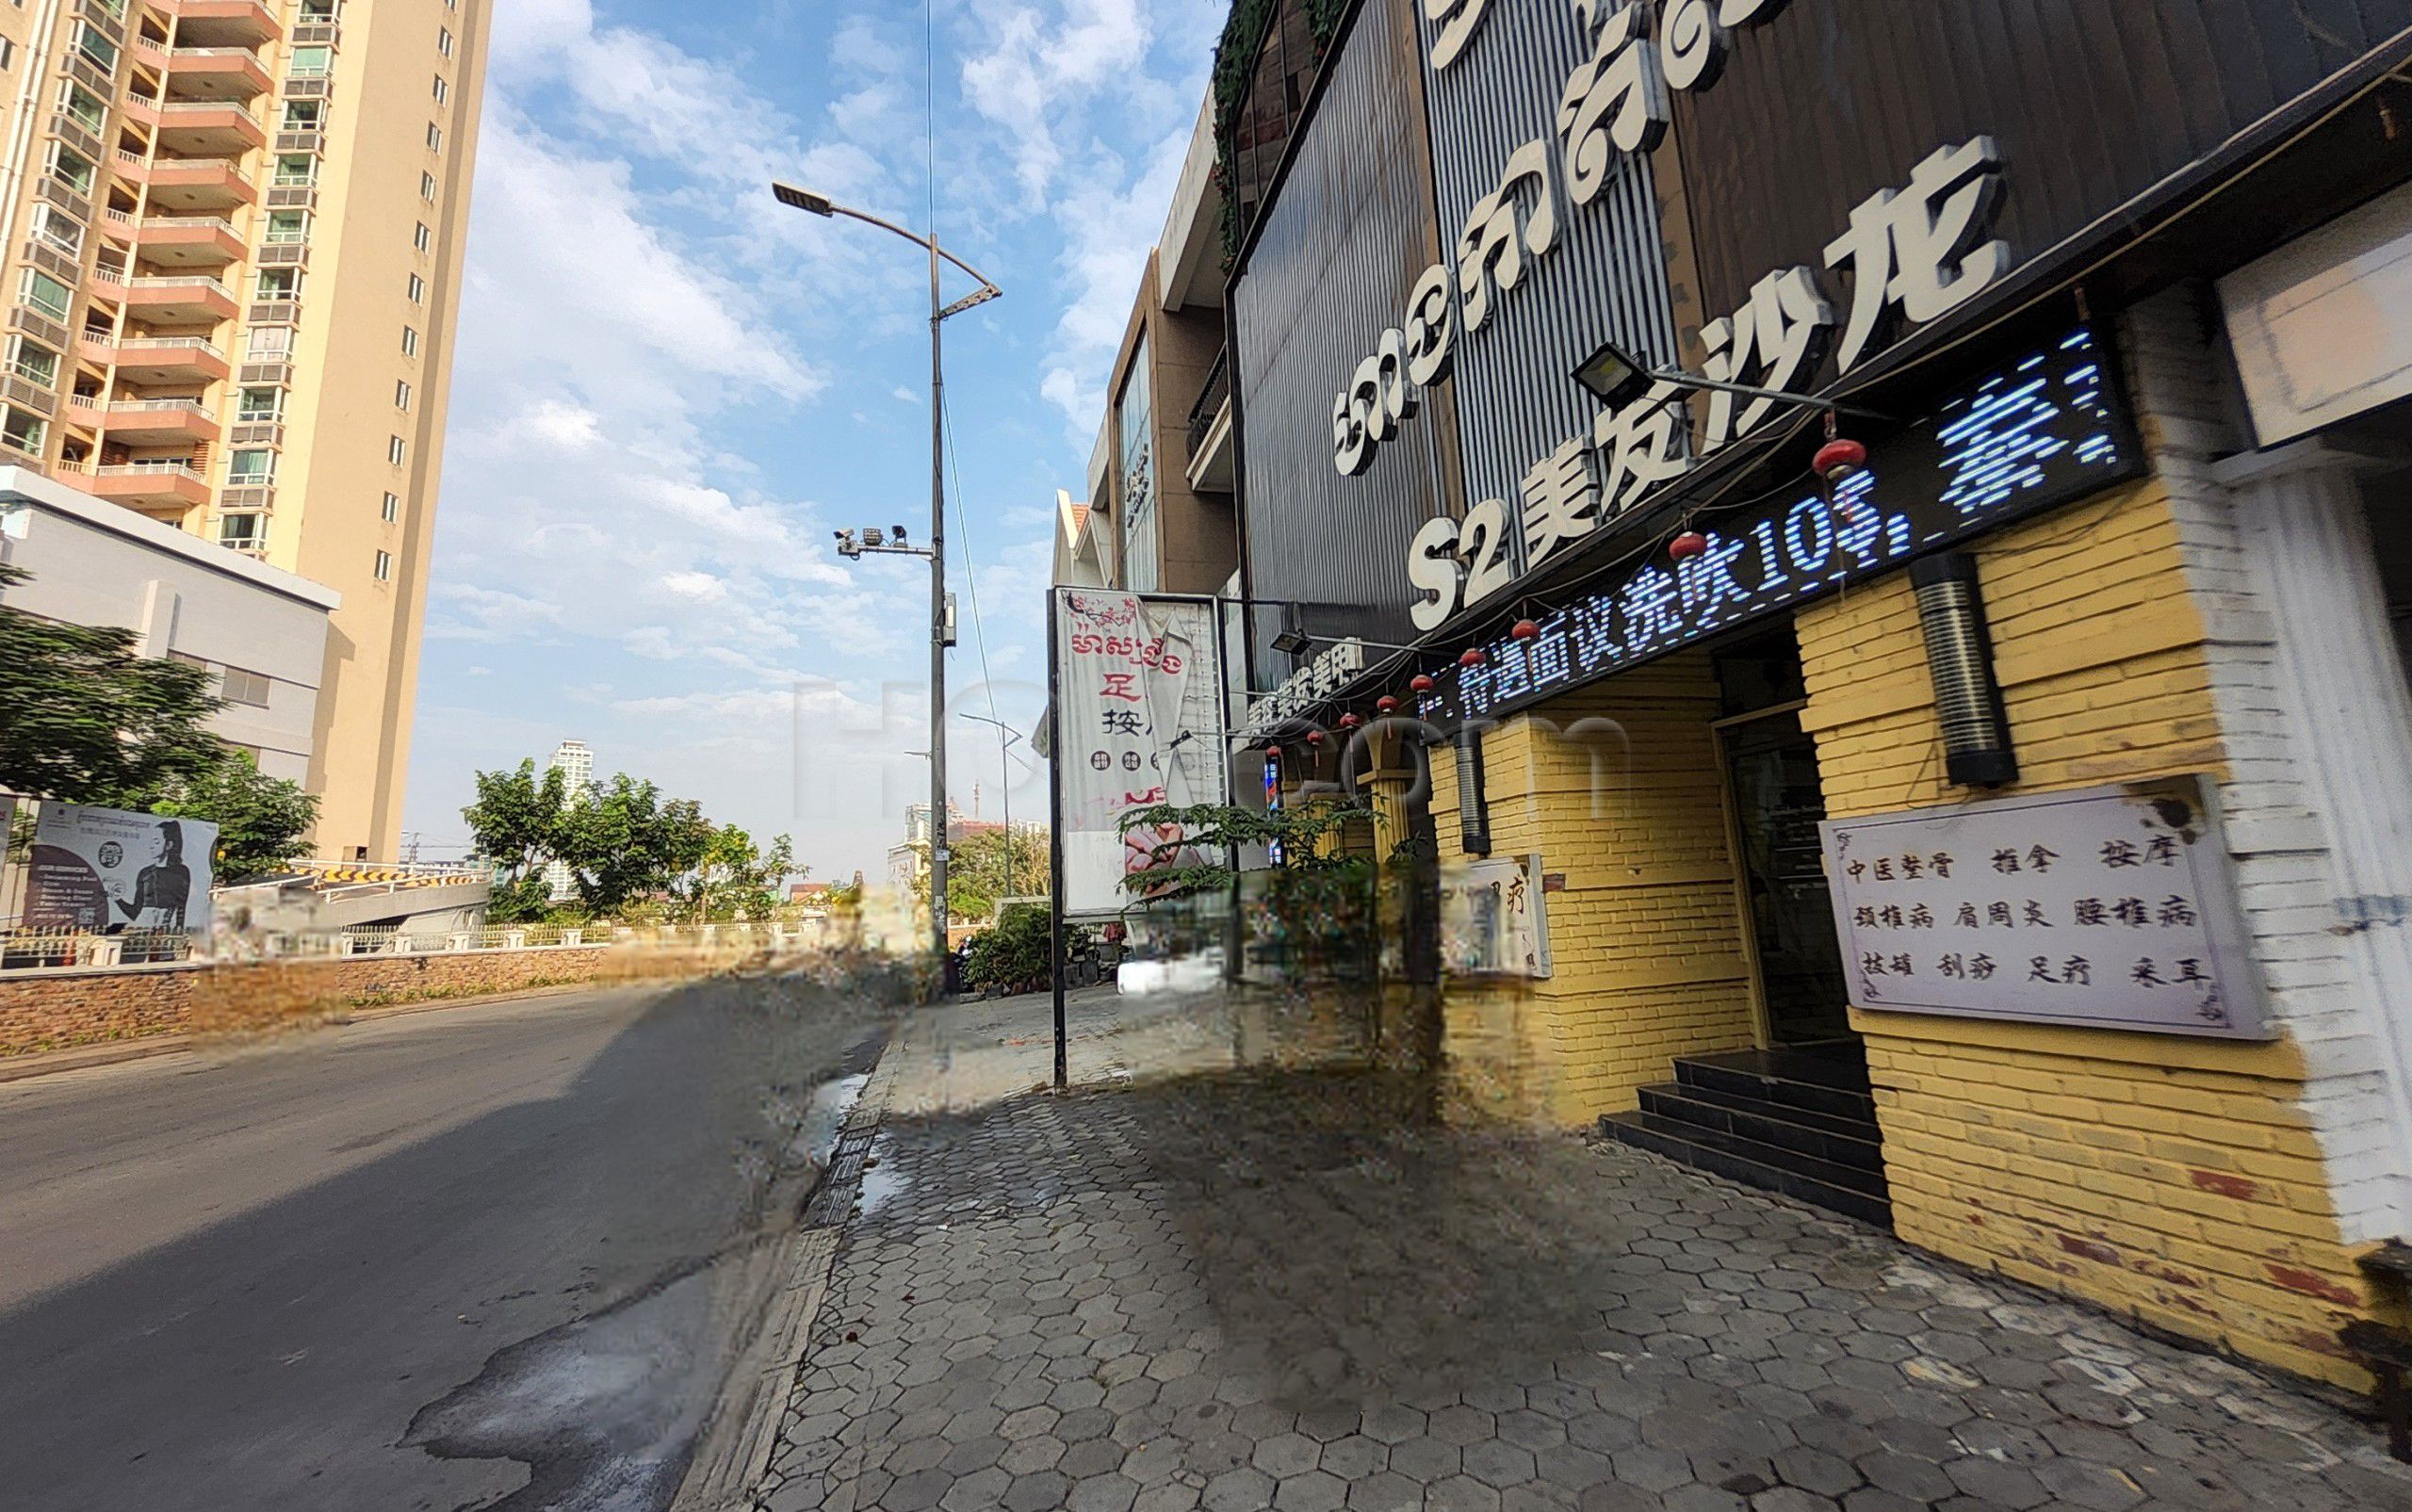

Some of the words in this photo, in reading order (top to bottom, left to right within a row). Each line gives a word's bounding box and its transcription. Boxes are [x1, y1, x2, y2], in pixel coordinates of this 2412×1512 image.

[1100, 708, 1154, 738] 按
[1847, 851, 1955, 885] 中医整骨
[1990, 844, 2061, 876] 推拿
[2097, 834, 2182, 871] 按摩
[1853, 901, 1935, 931] 颈椎病
[1952, 899, 2055, 930] 肩周炎
[2073, 893, 2197, 931] 腰椎病
[1935, 951, 1997, 982] 刮痧
[2026, 954, 2093, 987] 足疗
[2128, 957, 2213, 989] 采耳
